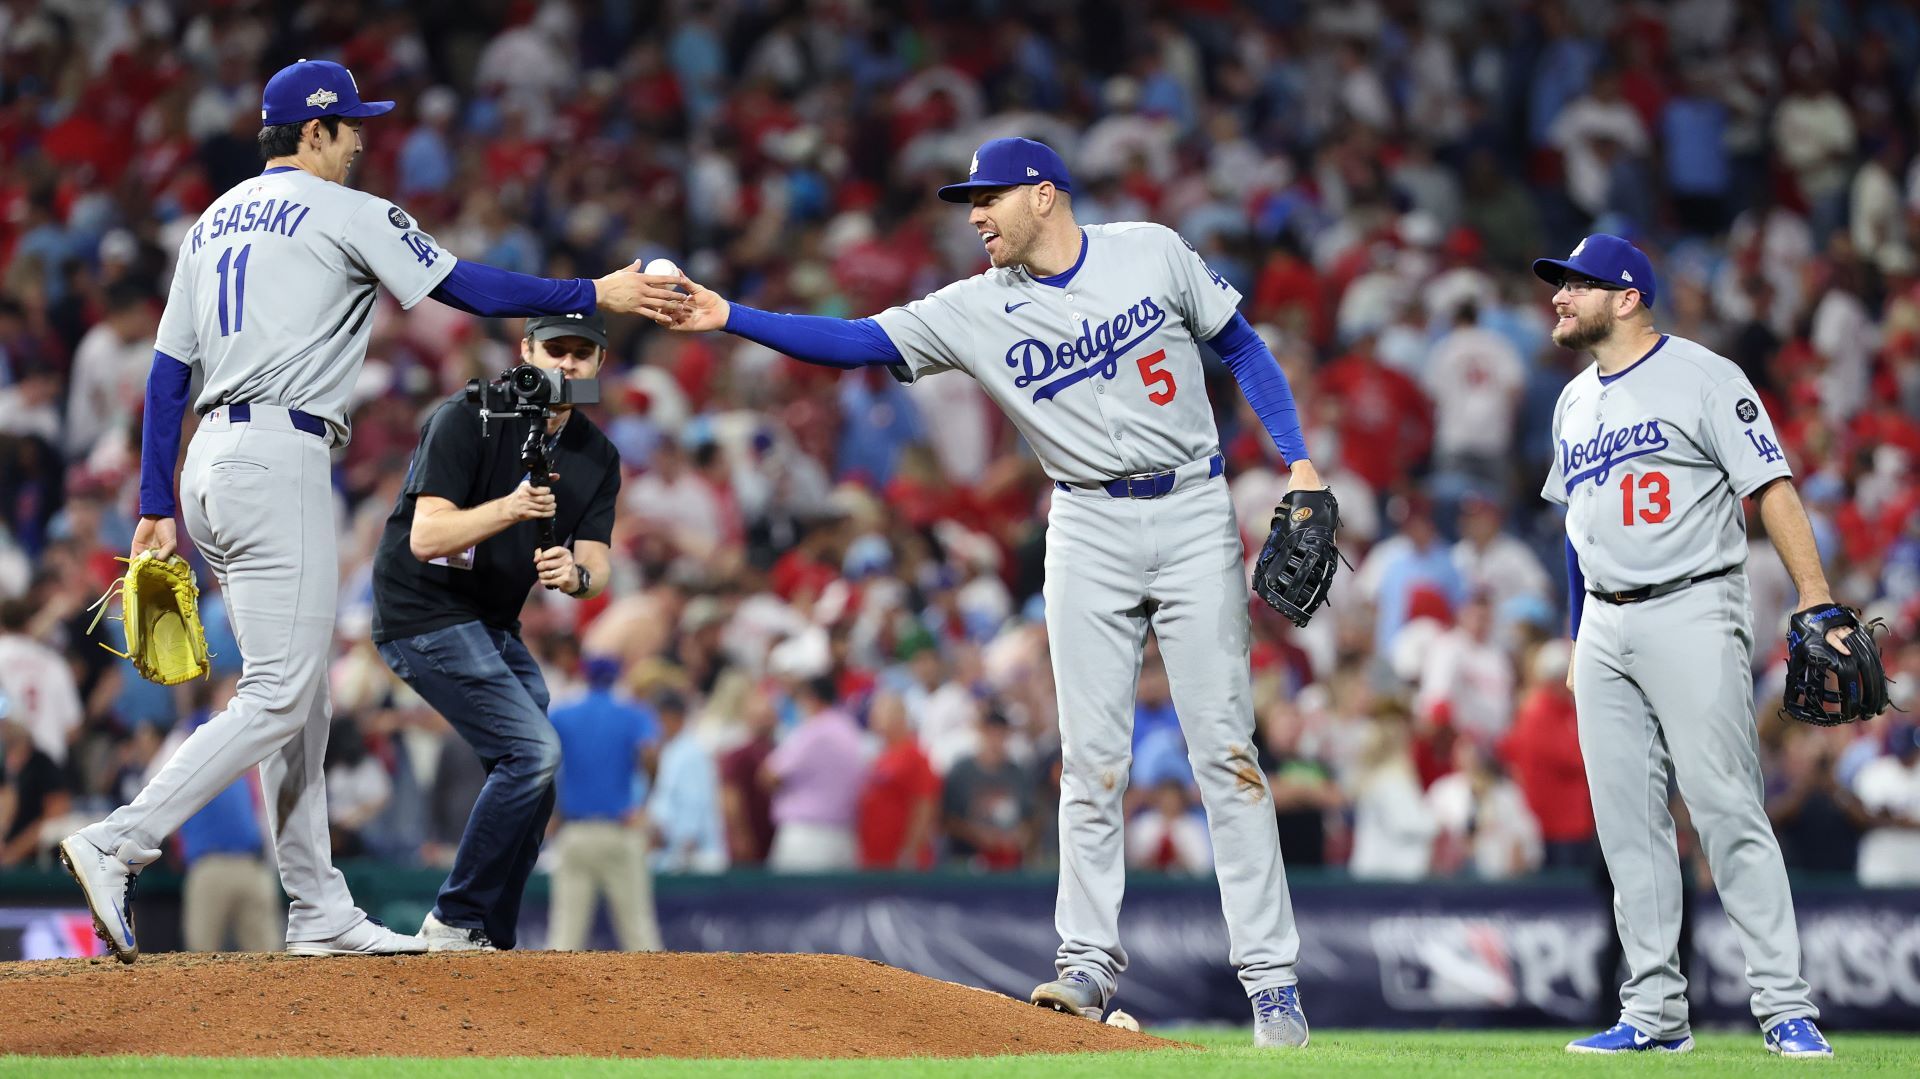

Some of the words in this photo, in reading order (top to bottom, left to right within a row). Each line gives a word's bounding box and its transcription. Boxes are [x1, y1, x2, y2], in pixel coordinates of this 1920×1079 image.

[191, 222, 206, 254] R.
[210, 199, 311, 239] SASAKI
[400, 232, 439, 268] LA
[216, 243, 252, 338] 11
[1005, 296, 1167, 404] Dodgers
[1135, 348, 1177, 406] 5
[1740, 404, 1756, 421] 34
[1744, 428, 1784, 463] LA
[1619, 471, 1671, 526] 13
